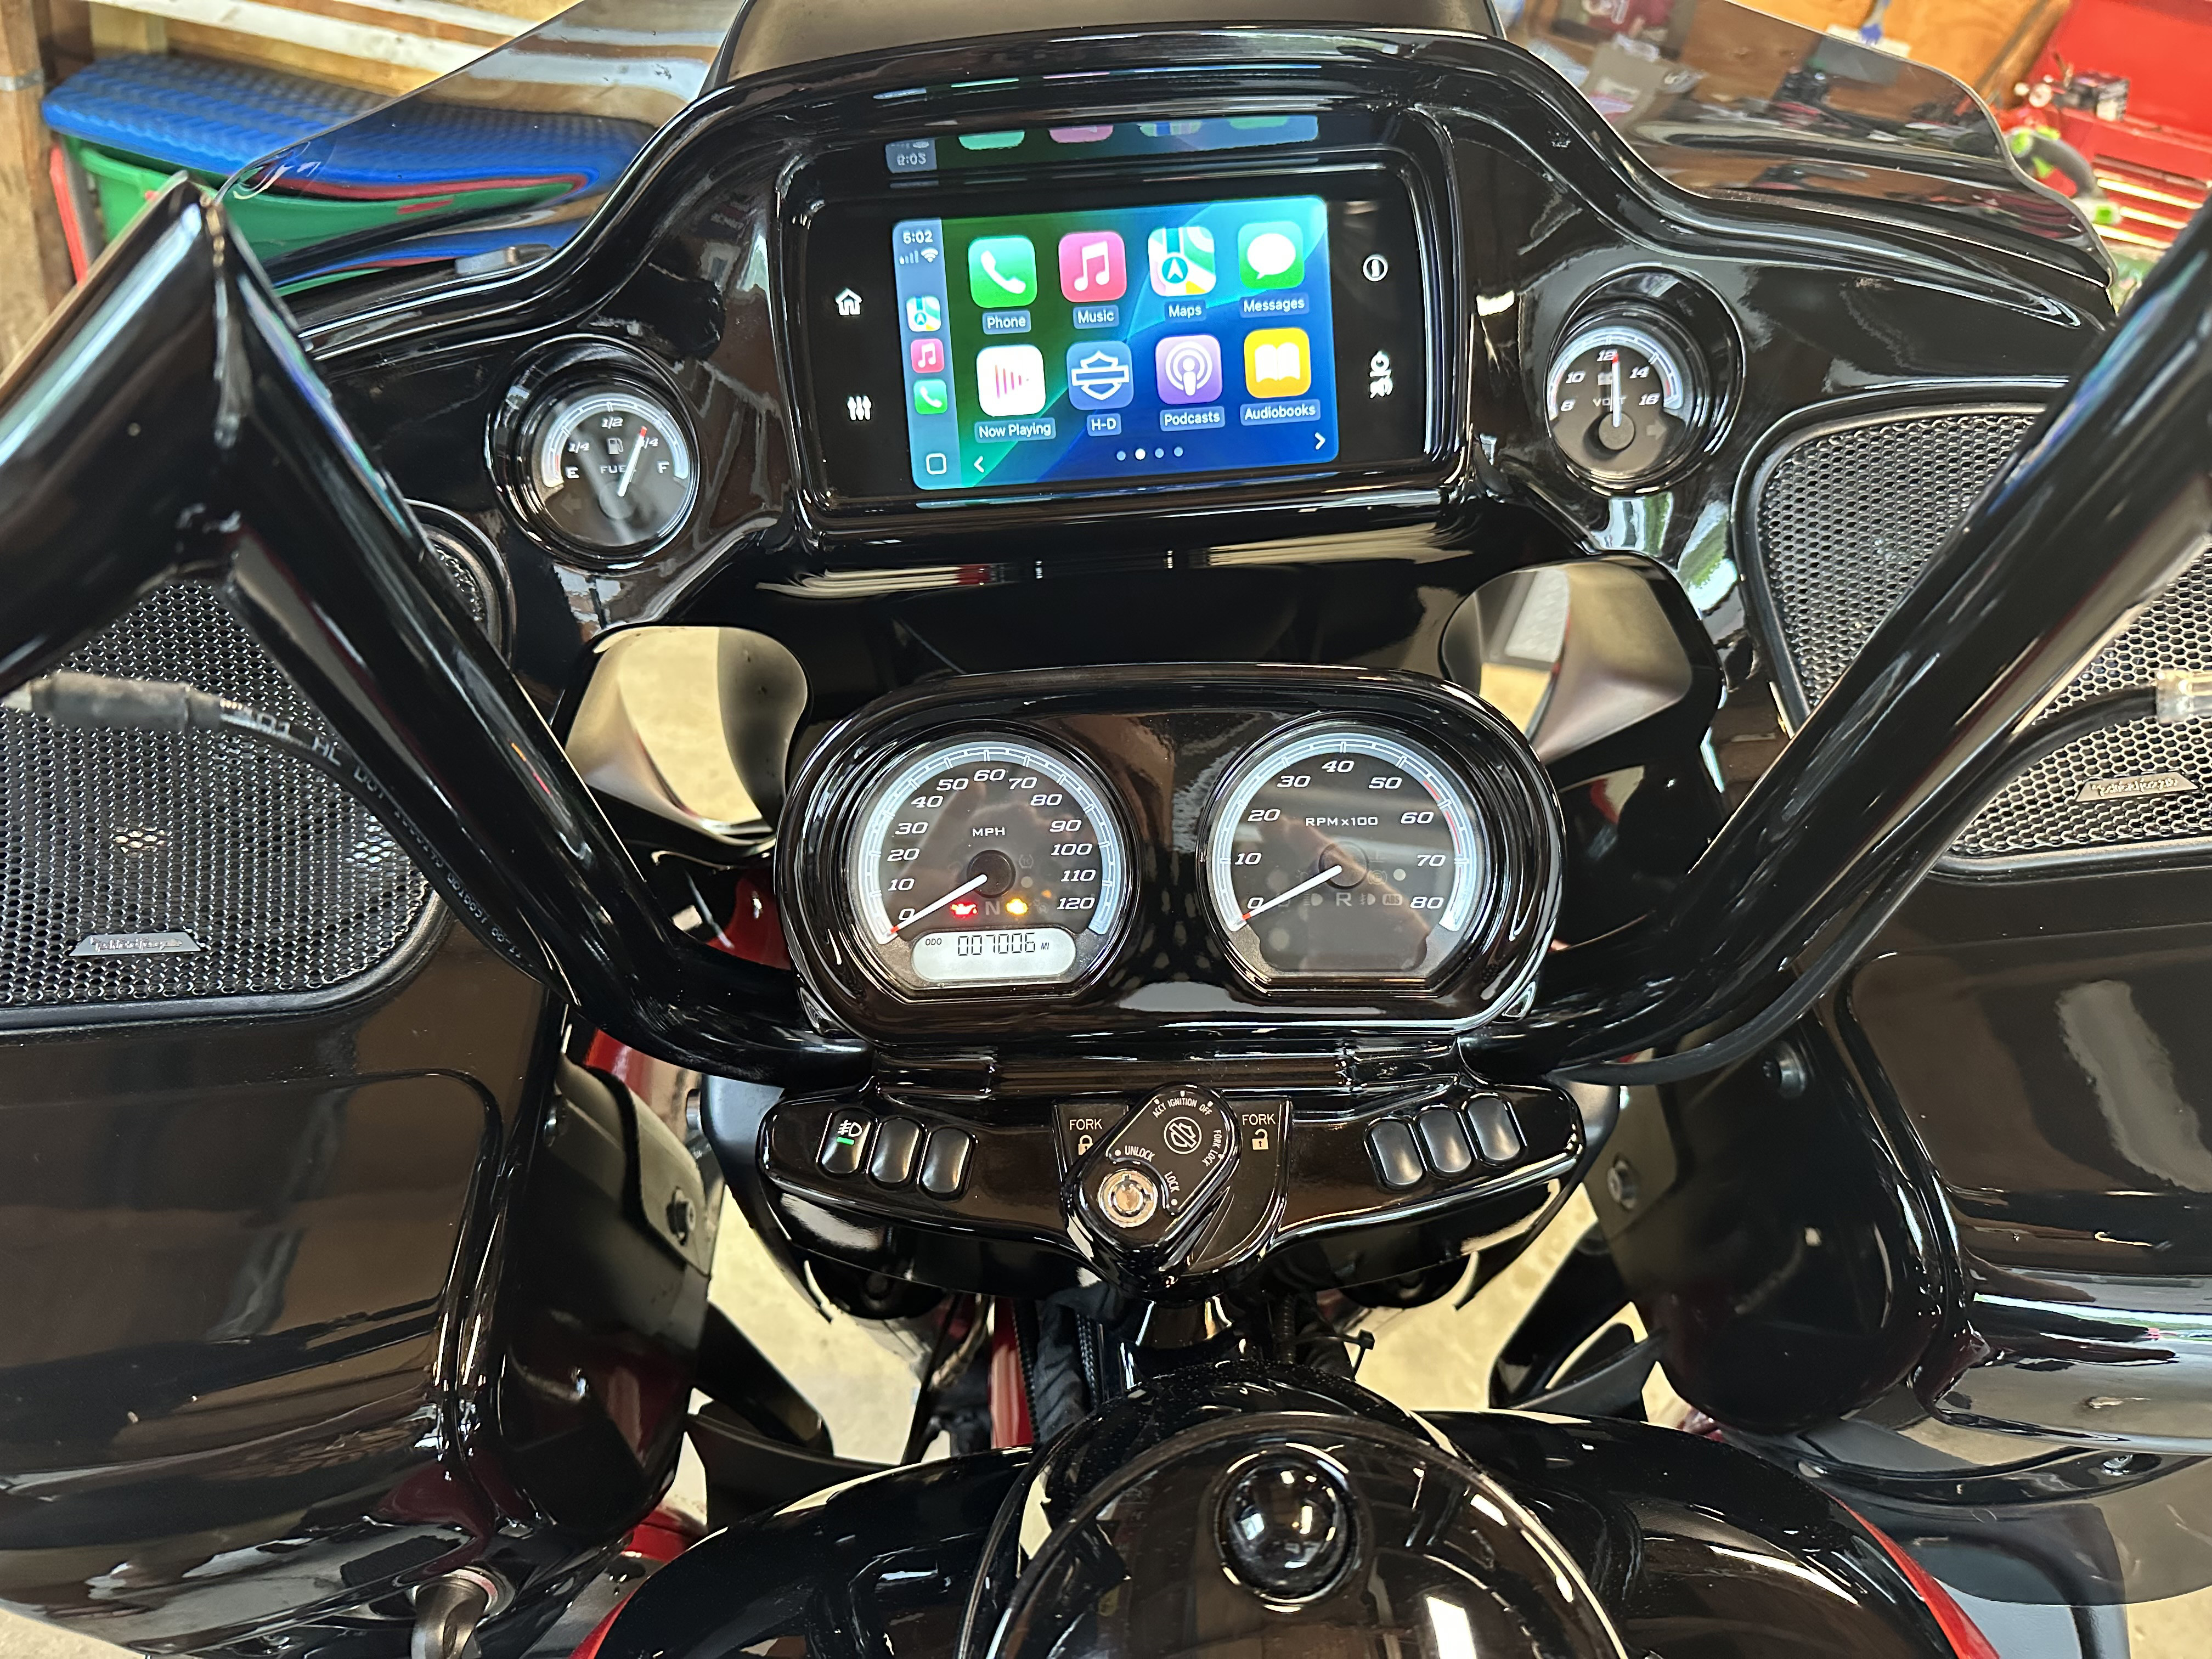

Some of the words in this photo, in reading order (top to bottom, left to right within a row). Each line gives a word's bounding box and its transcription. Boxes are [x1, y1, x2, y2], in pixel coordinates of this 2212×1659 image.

[902, 229, 933, 244] 5:02
[1169, 304, 1202, 319] Maps
[1243, 298, 1305, 313] Messages
[988, 315, 1026, 329] Phone
[1077, 309, 1114, 324] Music
[1597, 349, 1617, 362] 12
[1566, 371, 1586, 383] 10
[1629, 366, 1649, 379] 14
[1561, 399, 1576, 411] 8
[1592, 396, 1627, 407] VOT
[1164, 411, 1220, 426] Podcasts
[1244, 404, 1316, 421] Audiobooks
[601, 417, 623, 428] 1/2
[1091, 417, 1116, 431] H-D
[979, 426, 1006, 438] Now
[1008, 422, 1051, 437] Playing
[568, 442, 590, 453] 1/4
[566, 467, 579, 479] E
[600, 465, 637, 473] FUE
[657, 461, 669, 473] F
[1321, 760, 1355, 773] 40
[973, 769, 1007, 782] 60
[1277, 775, 1311, 788] 30
[936, 778, 969, 791] 50
[1008, 777, 1037, 789] 70
[1368, 777, 1402, 789] 50
[911, 795, 943, 808] 40
[1030, 794, 1062, 806] 80
[1248, 809, 1280, 821] 20
[1400, 811, 1434, 824] 60
[895, 822, 928, 835] 30
[972, 827, 1006, 837] MPH
[1049, 820, 1082, 832] 90
[887, 849, 919, 861] 20
[1051, 843, 1092, 856] 100
[1234, 853, 1262, 865] 10
[1416, 854, 1446, 867] 70
[1060, 870, 1096, 882] 110
[888, 878, 915, 891] 10
[1057, 897, 1094, 910] 120
[1246, 897, 1263, 910] 0
[1336, 893, 1352, 906] R
[1385, 895, 1400, 904] ABS
[1410, 896, 1444, 909] 80
[899, 908, 915, 921] 0
[985, 901, 1000, 915] N
[925, 938, 942, 946] ODO
[958, 932, 1036, 956] 007006
[1152, 1104, 1167, 1119] ACCY
[1167, 1097, 1197, 1108] IGNITION
[1199, 1104, 1212, 1116] OFF
[1069, 1119, 1103, 1131] FORK
[1242, 1114, 1276, 1126] FORK
[1212, 1129, 1222, 1150] FORK
[1125, 1145, 1155, 1163] UNLOCK
[1202, 1150, 1220, 1167] LOCK
[1164, 1171, 1180, 1193] LOCK
